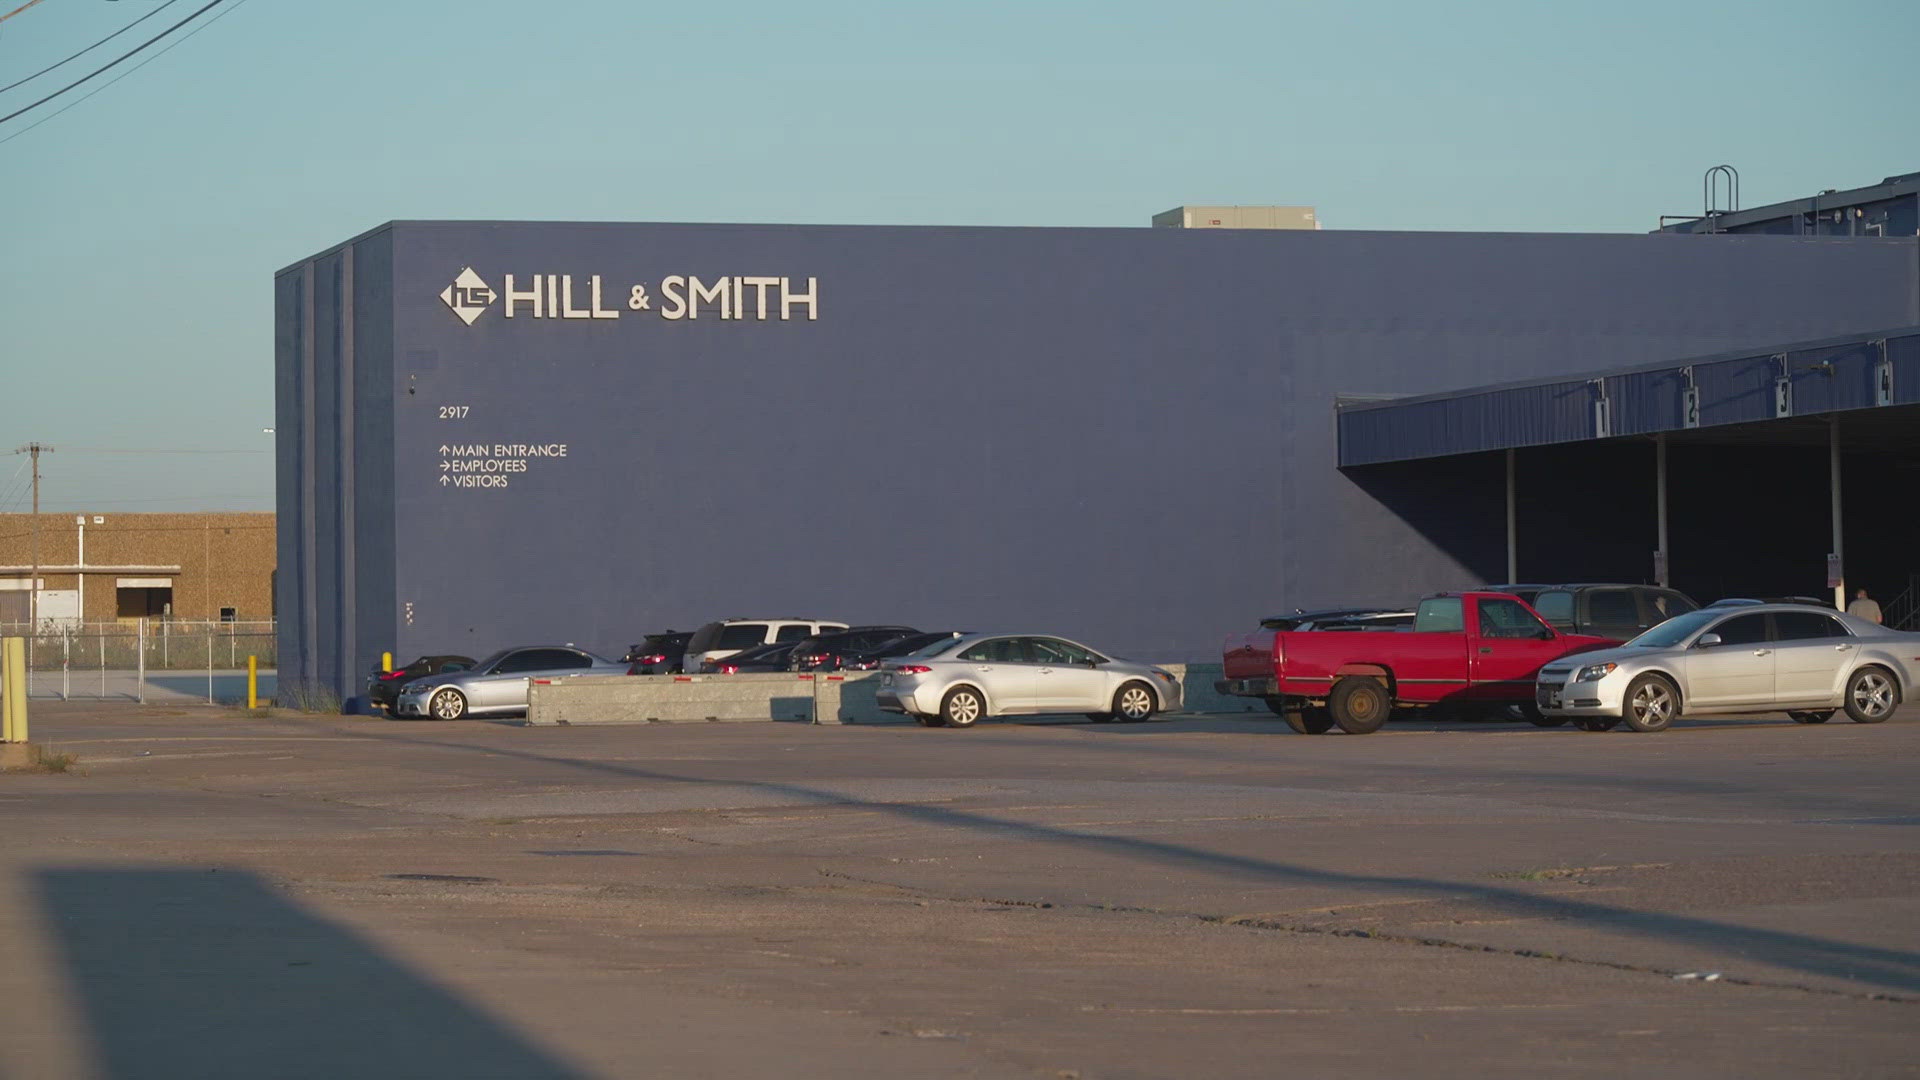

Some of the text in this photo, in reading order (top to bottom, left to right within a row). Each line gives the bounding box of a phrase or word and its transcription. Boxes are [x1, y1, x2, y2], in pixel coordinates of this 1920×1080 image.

[504, 274, 818, 321] HILL & SMITH
[1780, 382, 1788, 412] 3
[1881, 368, 1889, 400] 4
[439, 406, 469, 419] 2917
[1600, 403, 1606, 433] 1
[1688, 393, 1696, 423] 2
[452, 444, 567, 457] MAIN ENTRANCE
[452, 459, 527, 472] EMPLOYEES
[453, 475, 508, 488] VISITORS
